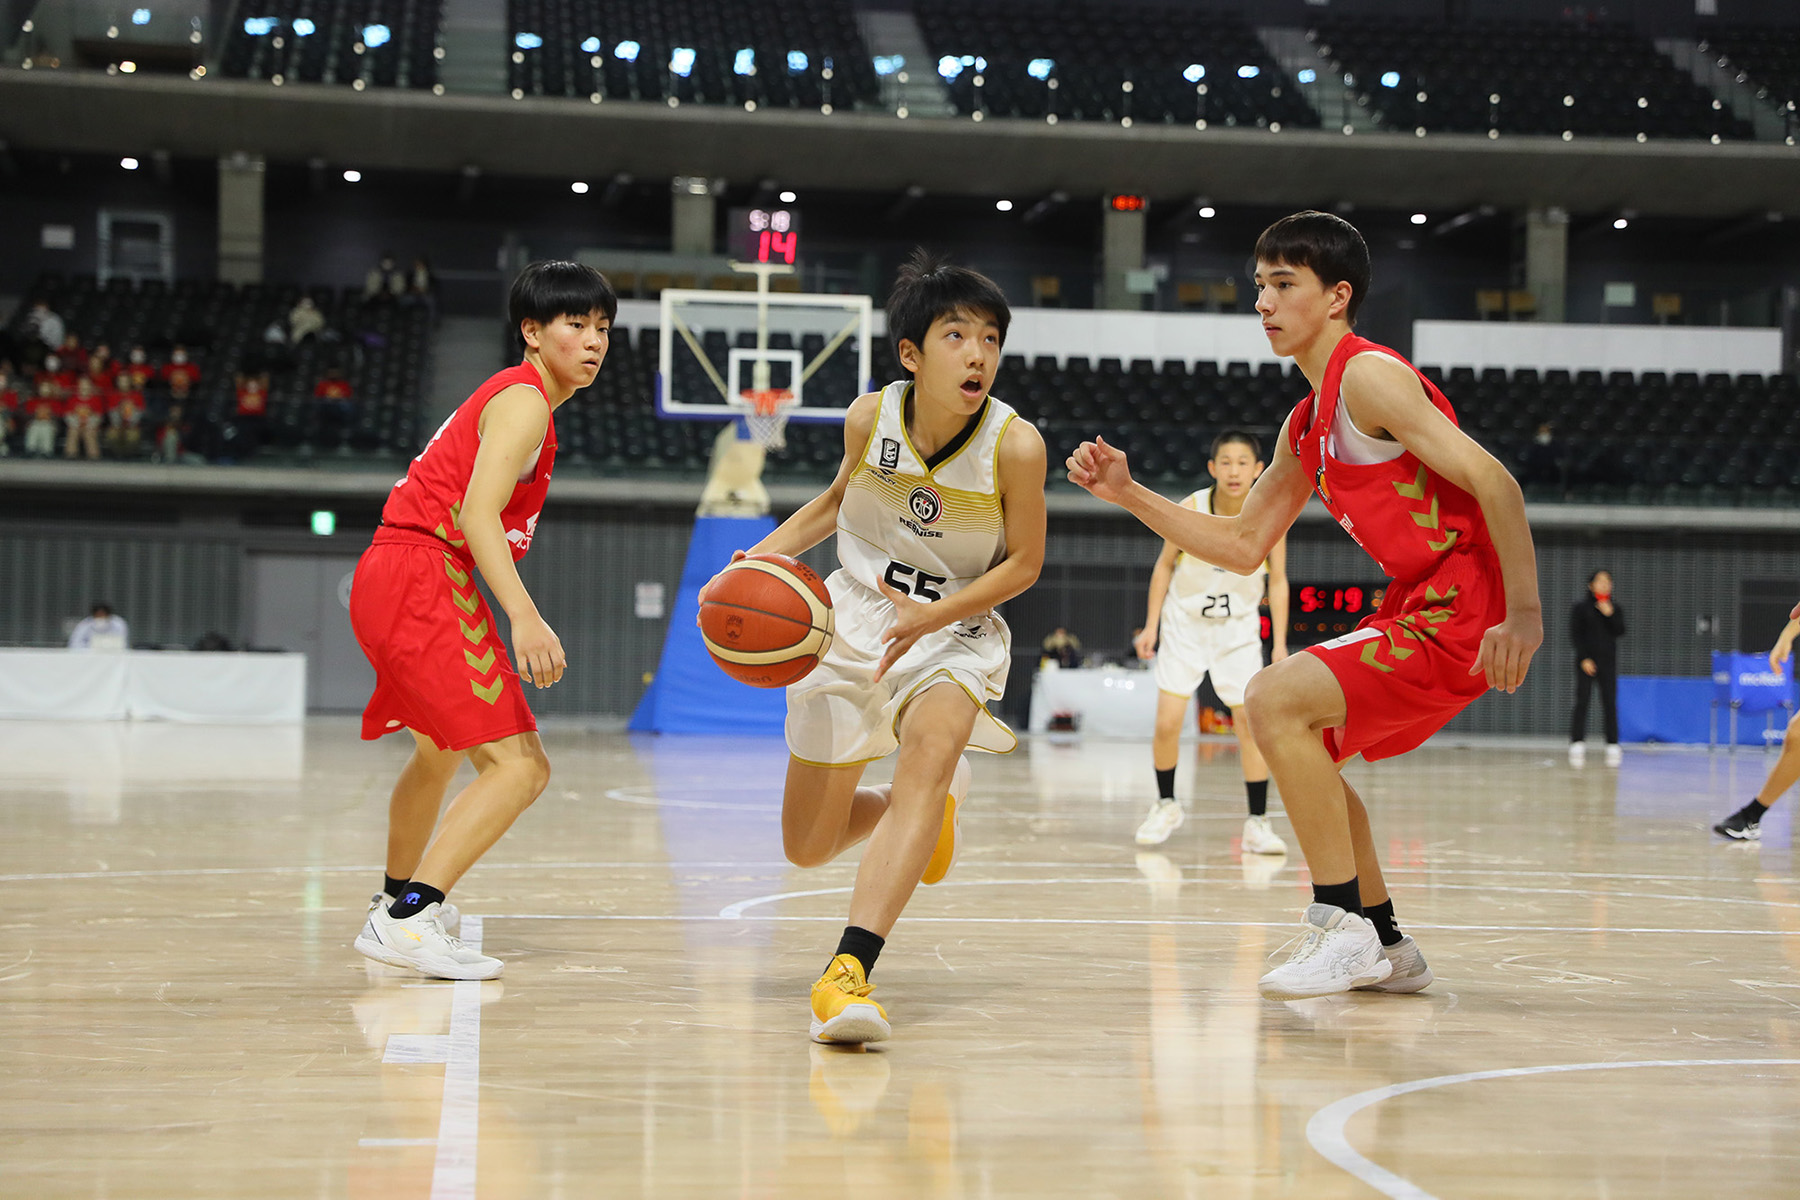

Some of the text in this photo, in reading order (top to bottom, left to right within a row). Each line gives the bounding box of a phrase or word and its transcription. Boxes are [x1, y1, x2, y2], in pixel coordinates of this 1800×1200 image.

[758, 230, 798, 264] 14
[884, 560, 947, 603] 55
[1201, 594, 1231, 619] 23
[1299, 586, 1364, 614] 5:19
